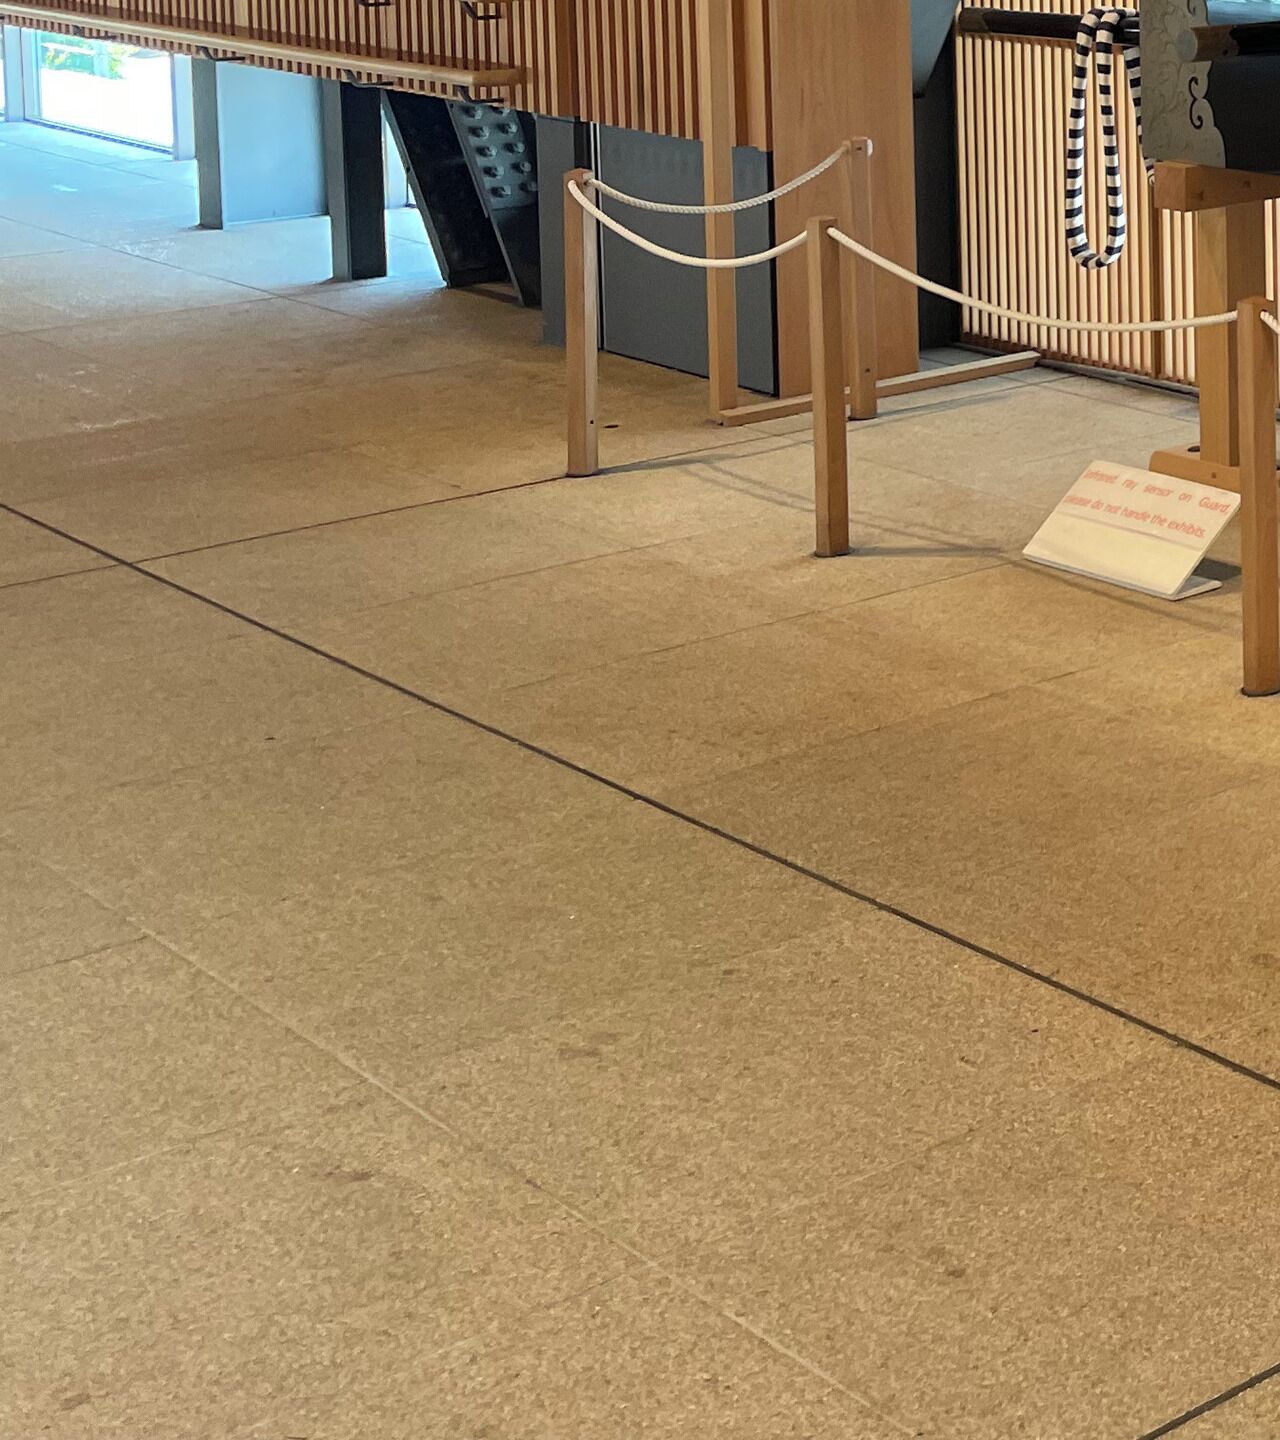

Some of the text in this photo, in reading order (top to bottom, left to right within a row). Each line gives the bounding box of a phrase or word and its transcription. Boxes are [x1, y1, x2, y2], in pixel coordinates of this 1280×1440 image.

[1143, 485, 1174, 497] sensor
[1178, 493, 1193, 502] on
[1091, 499, 1104, 510] do
[1104, 503, 1122, 514] not
[1121, 507, 1151, 522] handle
[1152, 514, 1167, 526] the
